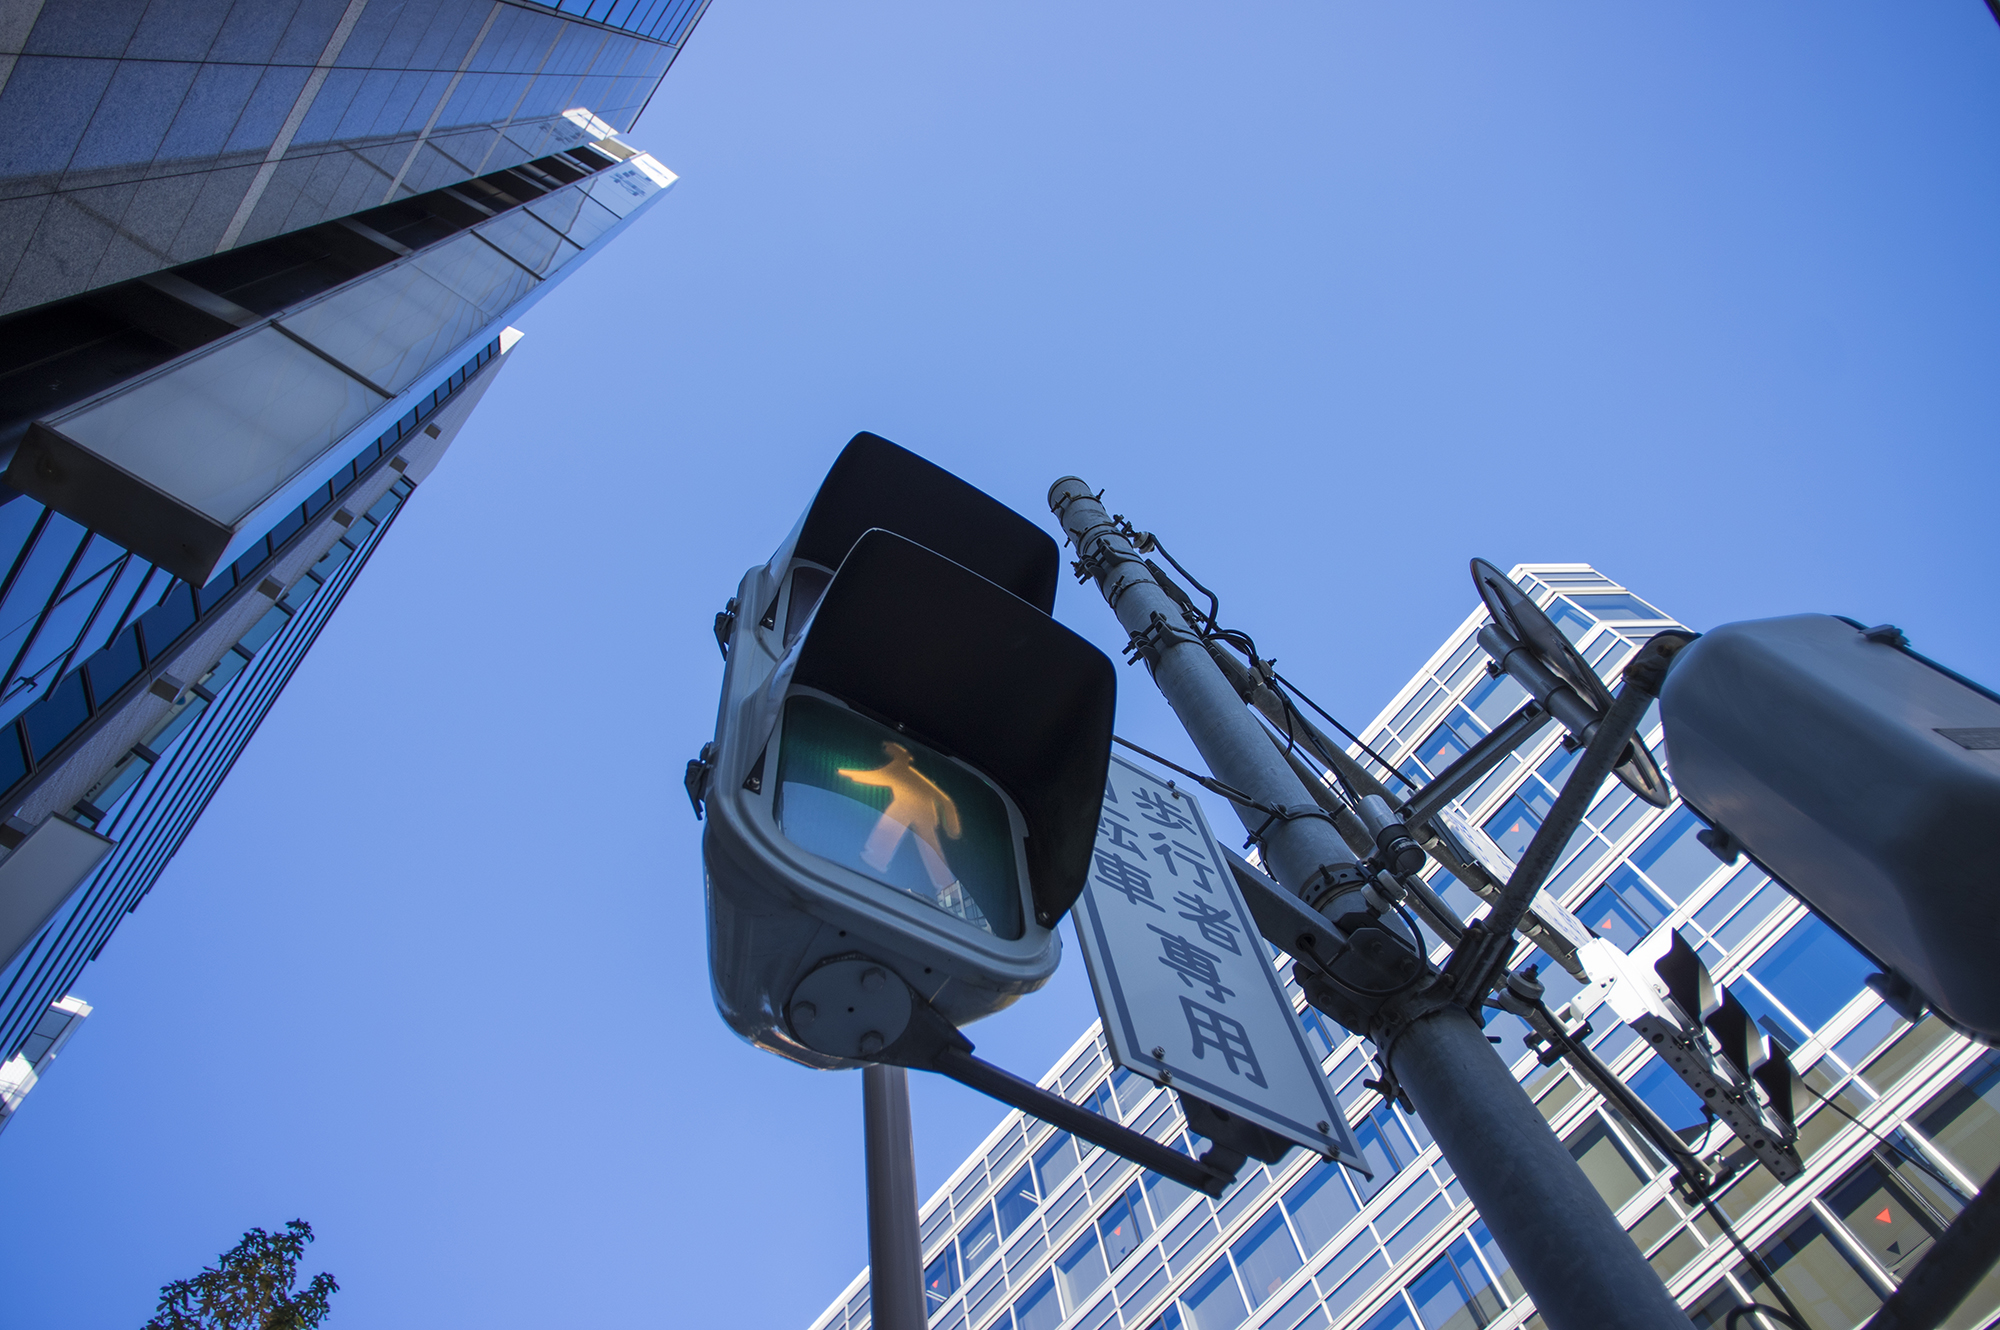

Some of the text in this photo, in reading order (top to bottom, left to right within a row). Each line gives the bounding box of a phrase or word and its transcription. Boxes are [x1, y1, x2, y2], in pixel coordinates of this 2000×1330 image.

[1093, 776, 1166, 913] 転車
[1131, 786, 1242, 956] 歩行者
[1146, 922, 1268, 1089] 専用
